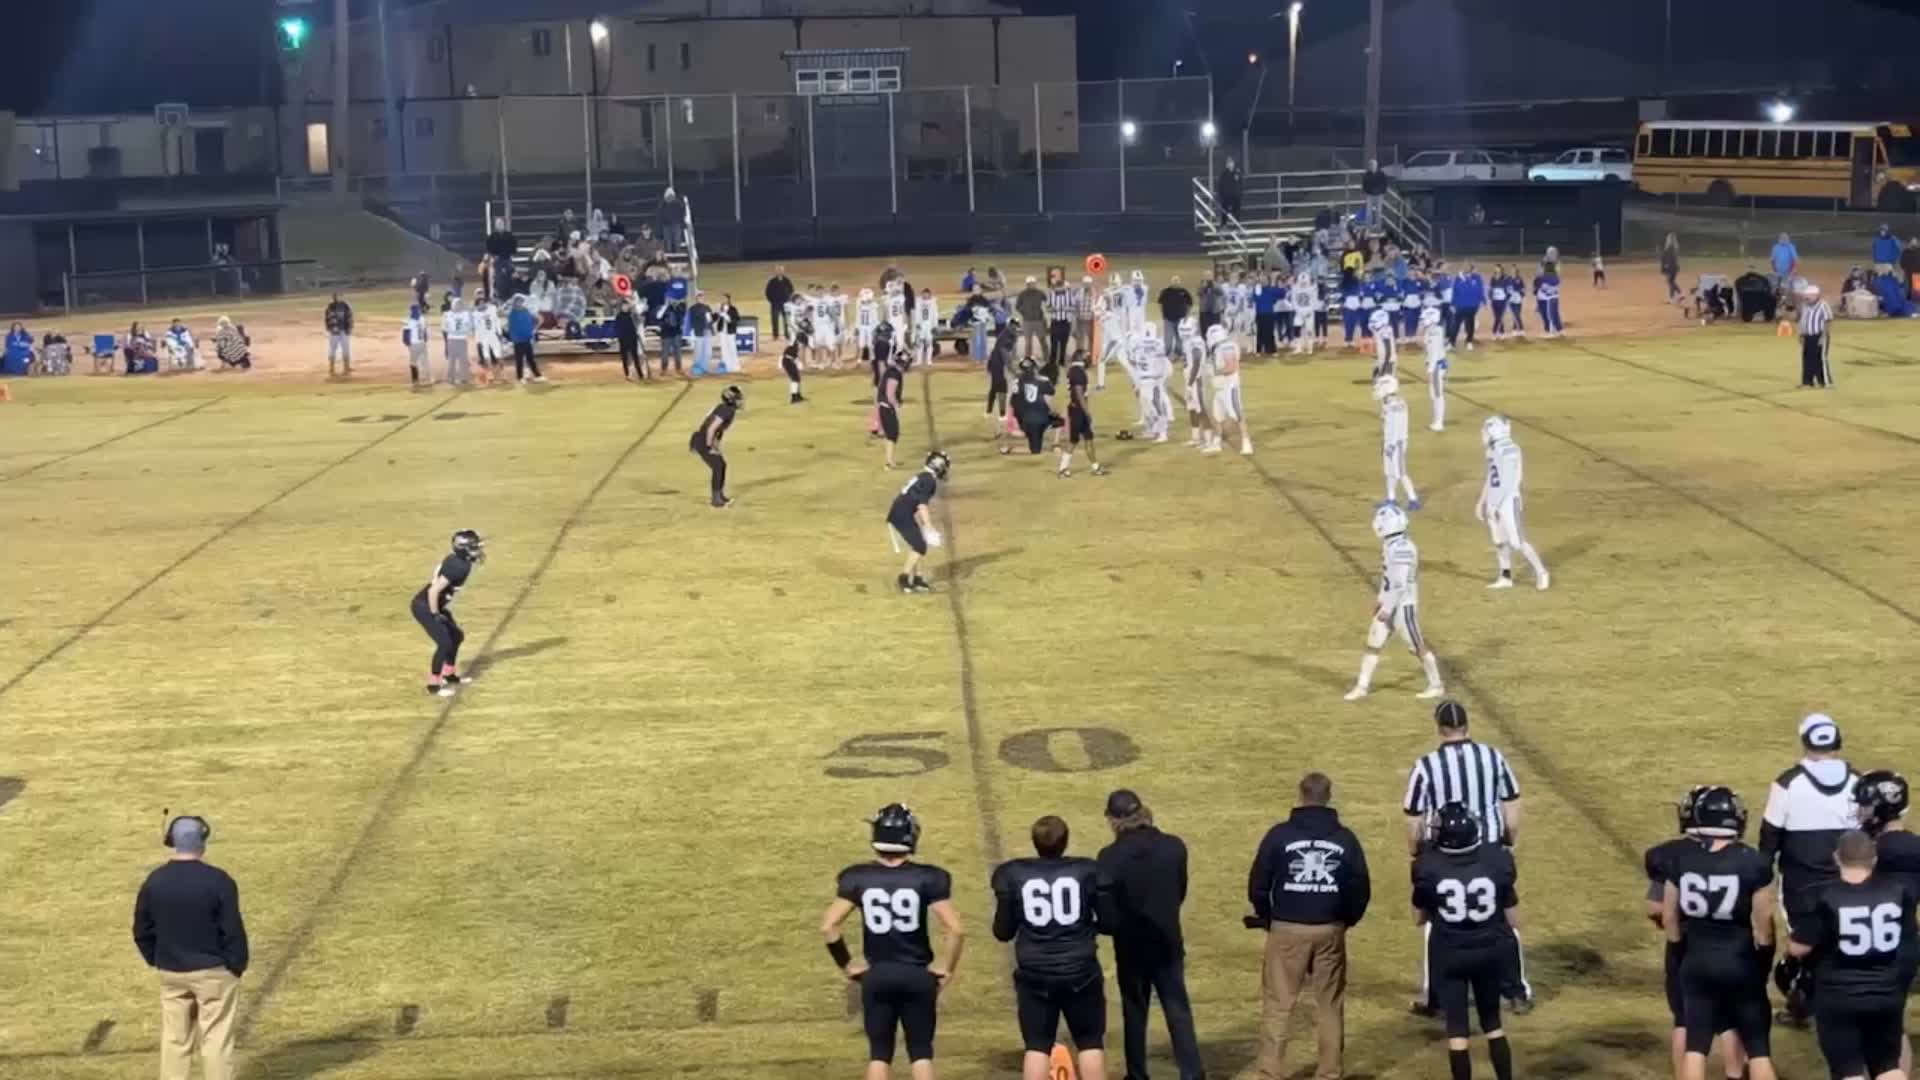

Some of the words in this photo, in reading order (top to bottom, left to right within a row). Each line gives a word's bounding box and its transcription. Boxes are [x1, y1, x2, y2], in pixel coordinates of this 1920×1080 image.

[818, 727, 1142, 778] 50
[861, 888, 920, 934] 69
[1022, 877, 1081, 927] 60
[1436, 877, 1498, 923] 33
[1679, 872, 1741, 920] 67
[1838, 902, 1903, 956] 56
